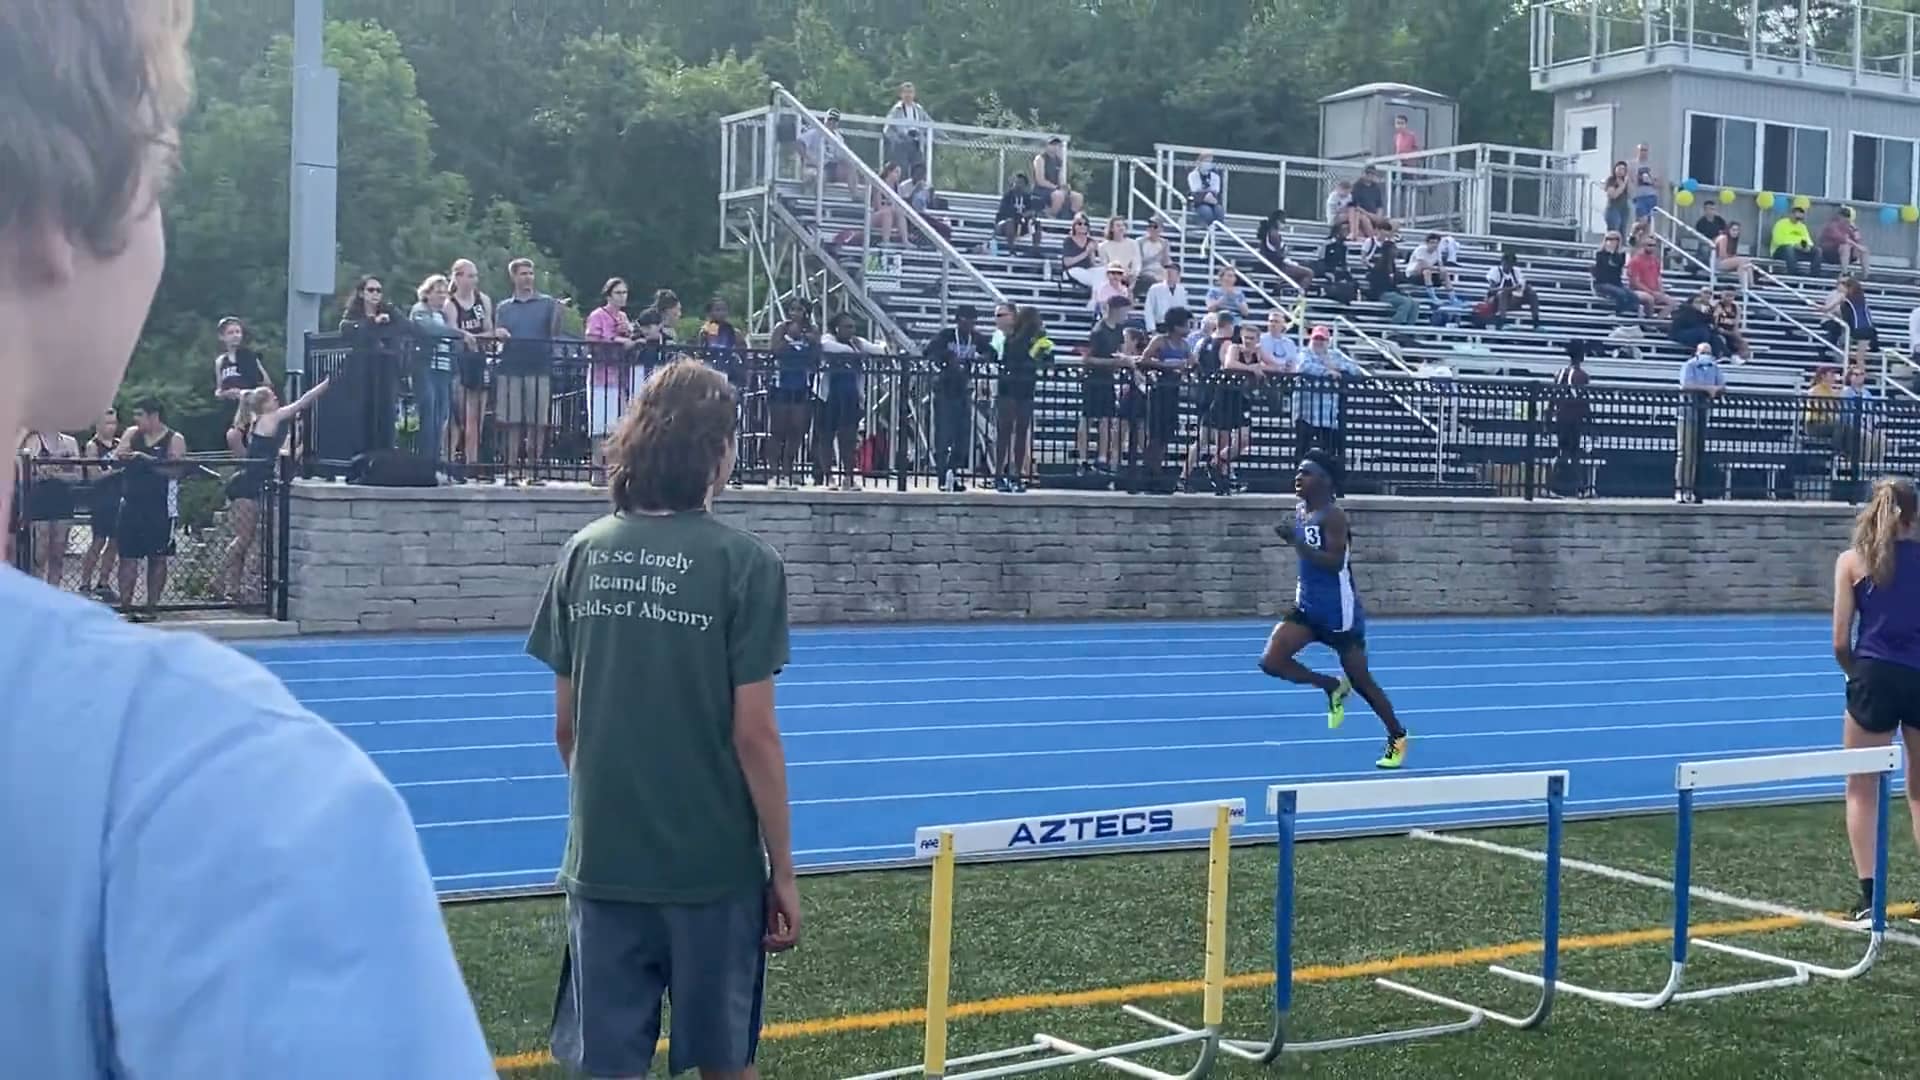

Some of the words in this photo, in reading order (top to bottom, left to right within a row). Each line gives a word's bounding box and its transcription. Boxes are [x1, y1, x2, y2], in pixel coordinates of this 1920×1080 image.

[1306, 527, 1318, 545] 3
[613, 550, 635, 563] so
[639, 548, 693, 574] lonely
[589, 574, 647, 592] Round
[651, 575, 677, 595] the
[614, 600, 636, 616] of
[639, 601, 713, 631] Athenry
[1008, 809, 1173, 847] AZTECS
